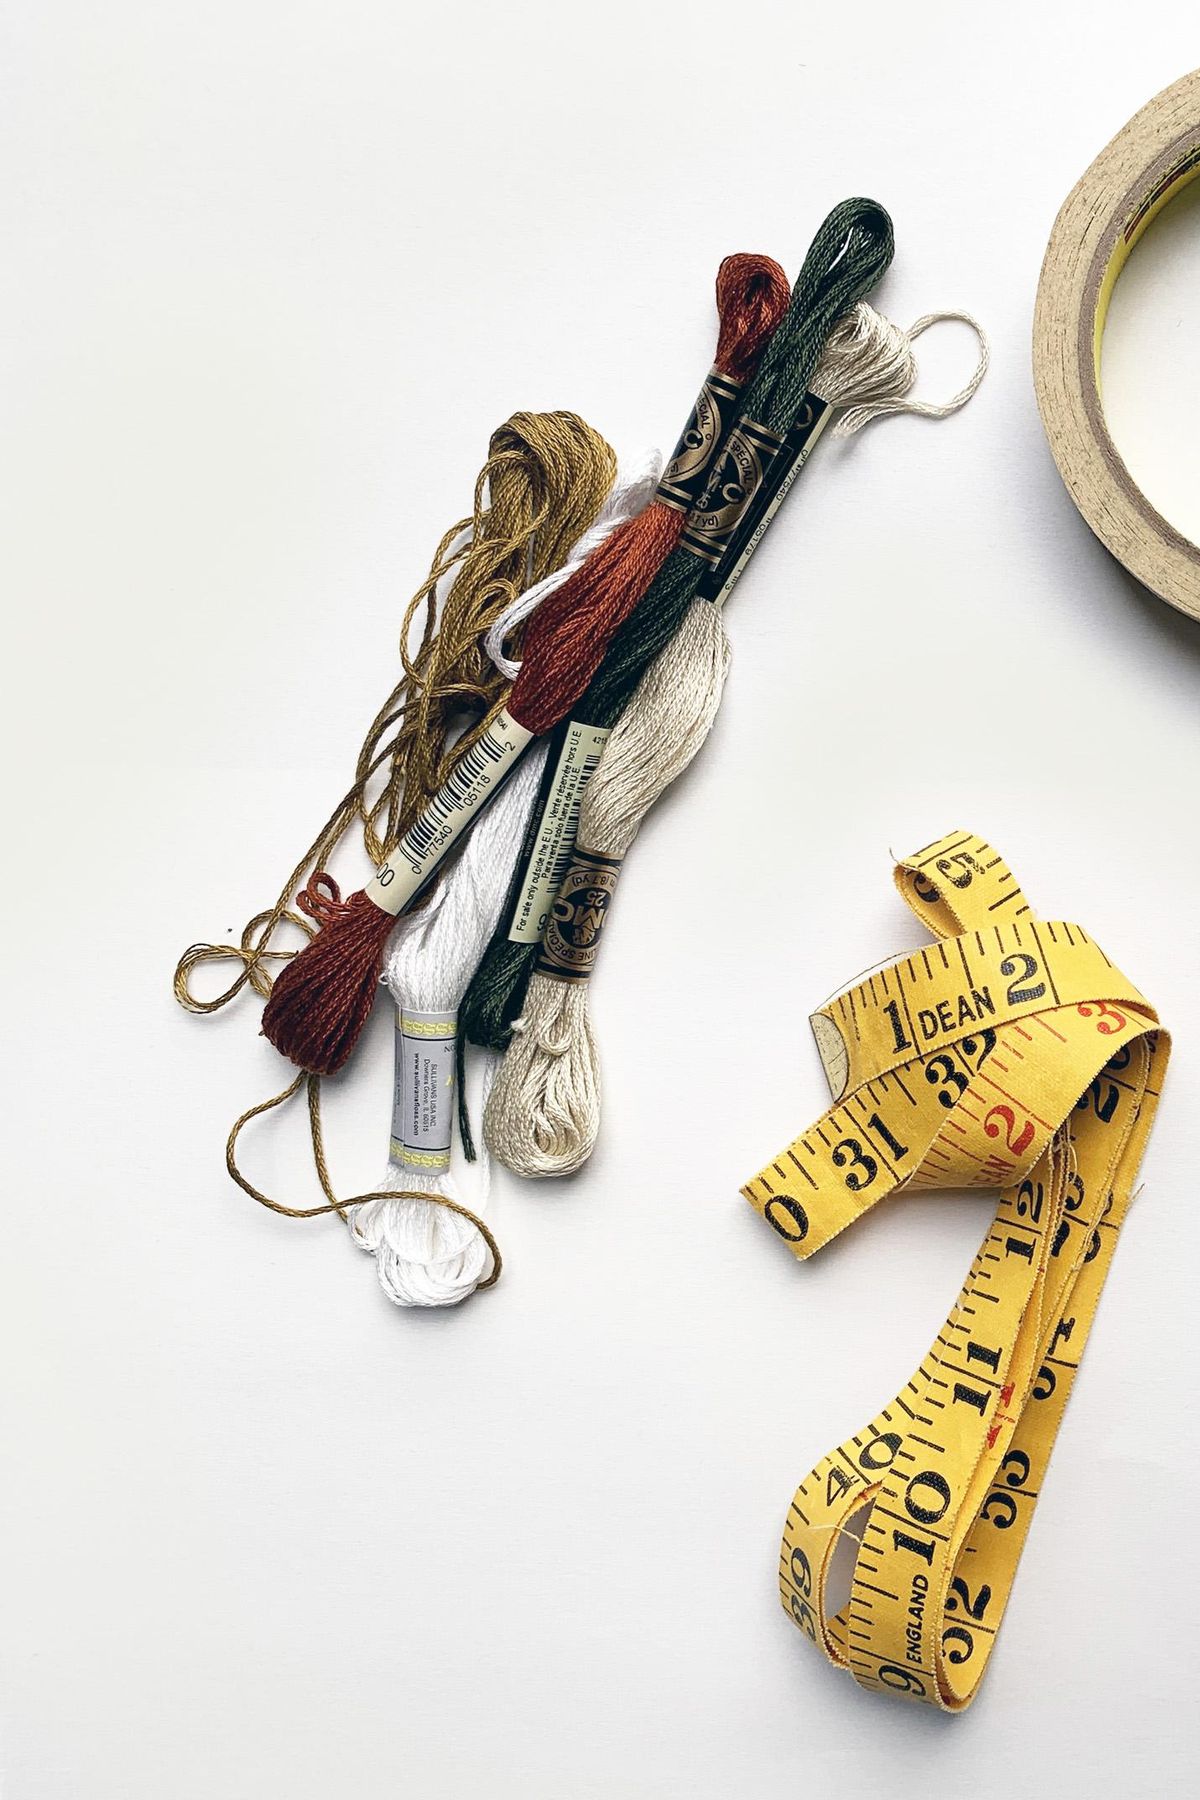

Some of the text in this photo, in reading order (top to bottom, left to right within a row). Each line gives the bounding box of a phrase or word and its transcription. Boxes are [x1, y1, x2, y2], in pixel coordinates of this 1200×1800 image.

[565, 747, 577, 763] hors
[557, 764, 571, 796] réservée
[567, 781, 576, 790] la
[563, 789, 573, 801] de
[411, 741, 516, 875] 0 77540 05118 2
[548, 798, 561, 818] Vente
[557, 801, 570, 822] fuera
[553, 821, 563, 838] solo
[539, 843, 549, 856] the
[547, 838, 559, 859] venta
[532, 857, 545, 884] outside
[540, 858, 552, 878] Para
[528, 885, 538, 900] only
[584, 891, 606, 907] 25
[523, 902, 532, 917] sale
[517, 919, 527, 931] For
[883, 953, 1047, 1055] 1 DEAN 2
[1077, 1001, 1128, 1036] 3
[984, 1104, 1036, 1157] 2
[831, 1112, 910, 1192] 31
[1004, 1180, 1044, 1266] 12
[952, 1339, 1003, 1417] 11
[892, 1471, 952, 1566] 10
[905, 1573, 930, 1664] ENGLAND
